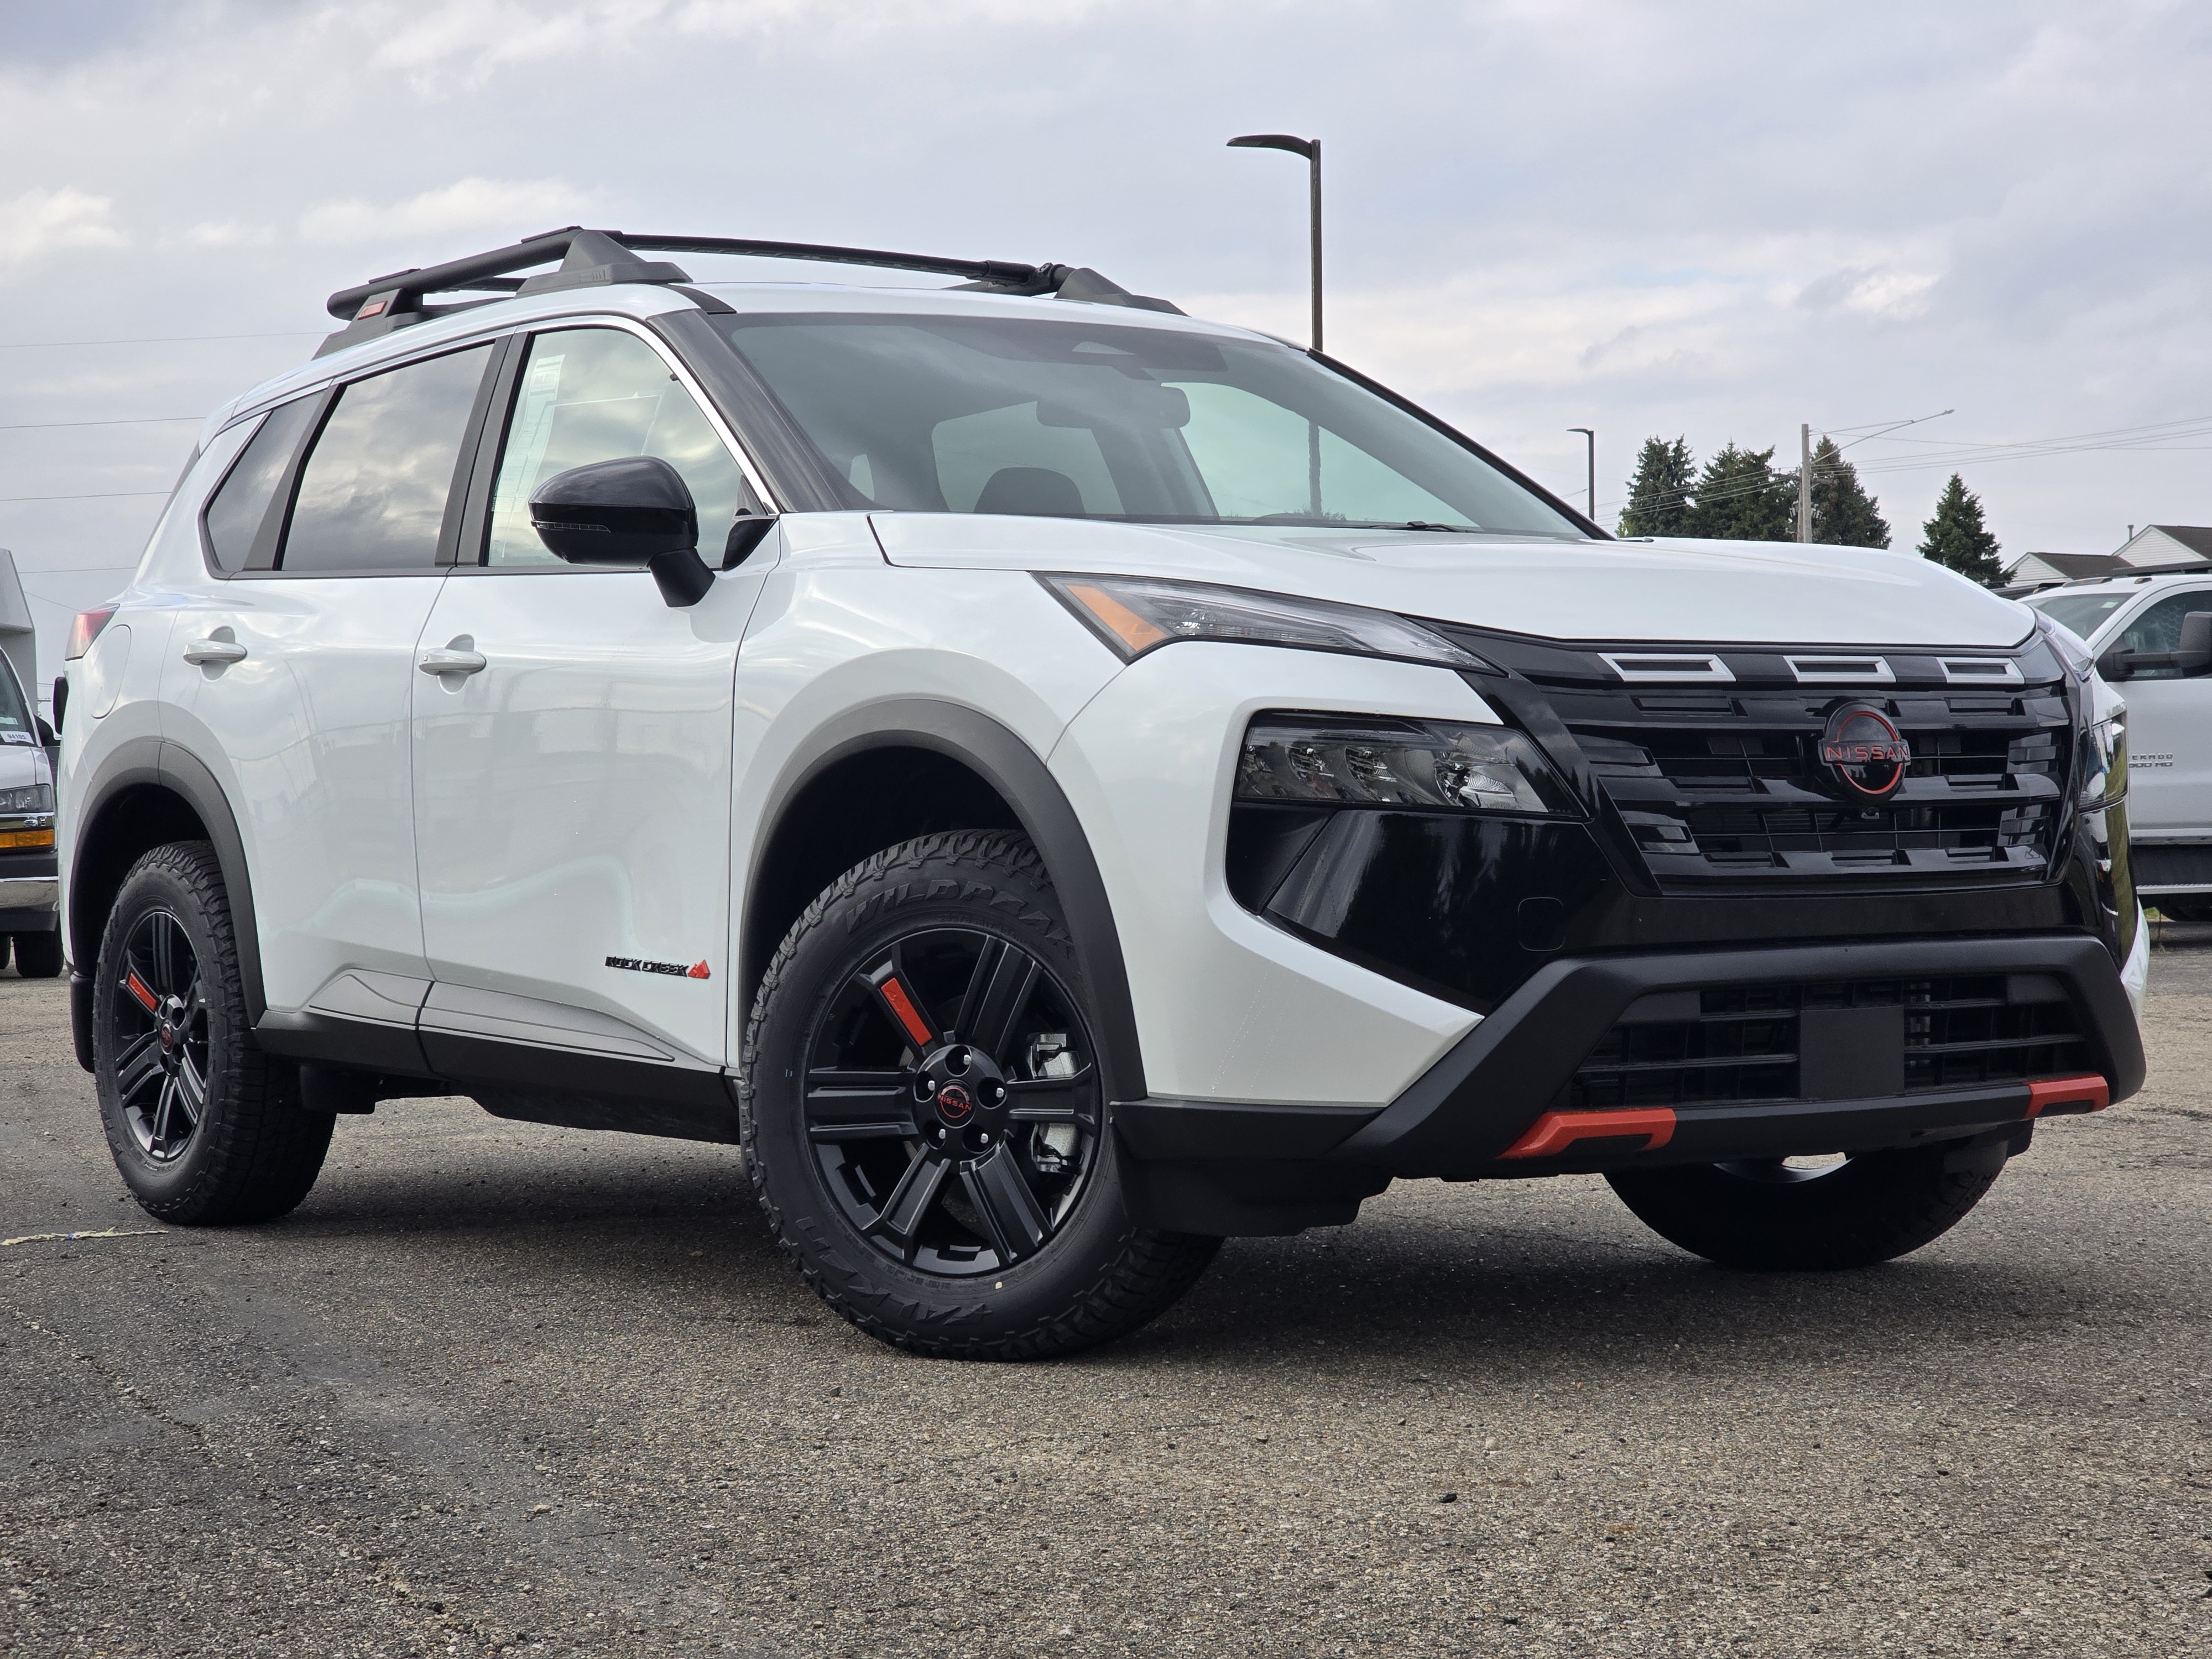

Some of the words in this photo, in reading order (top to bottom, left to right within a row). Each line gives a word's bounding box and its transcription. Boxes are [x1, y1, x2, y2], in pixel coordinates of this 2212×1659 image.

[1826, 745, 1910, 760] NISSAN
[846, 879, 1076, 960] WILDPEAK
[641, 960, 690, 978] CREEK
[937, 1093, 972, 1111] NISSAN
